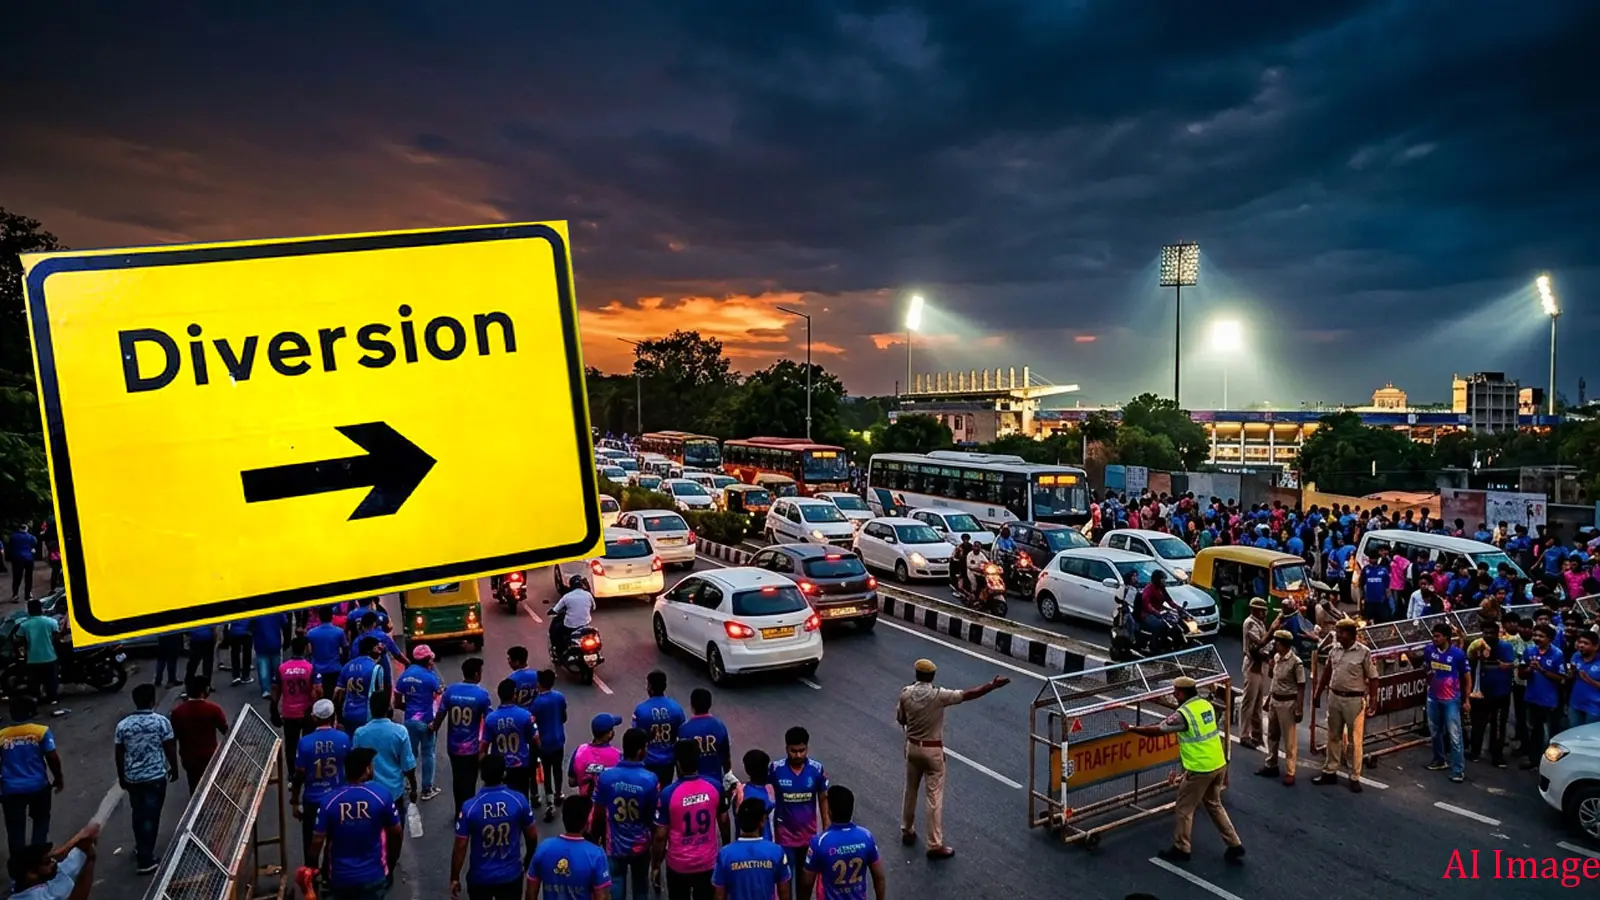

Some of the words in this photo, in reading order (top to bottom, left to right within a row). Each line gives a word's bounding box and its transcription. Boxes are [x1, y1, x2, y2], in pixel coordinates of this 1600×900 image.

[118, 303, 517, 393] Diversion
[1074, 740, 1132, 772] TRAFFIC
[1138, 732, 1178, 757] POLIC
[314, 757, 337, 778] 15
[339, 801, 371, 821] RR
[483, 801, 508, 819] RR
[683, 809, 711, 837] 19
[832, 857, 863, 885] 22
